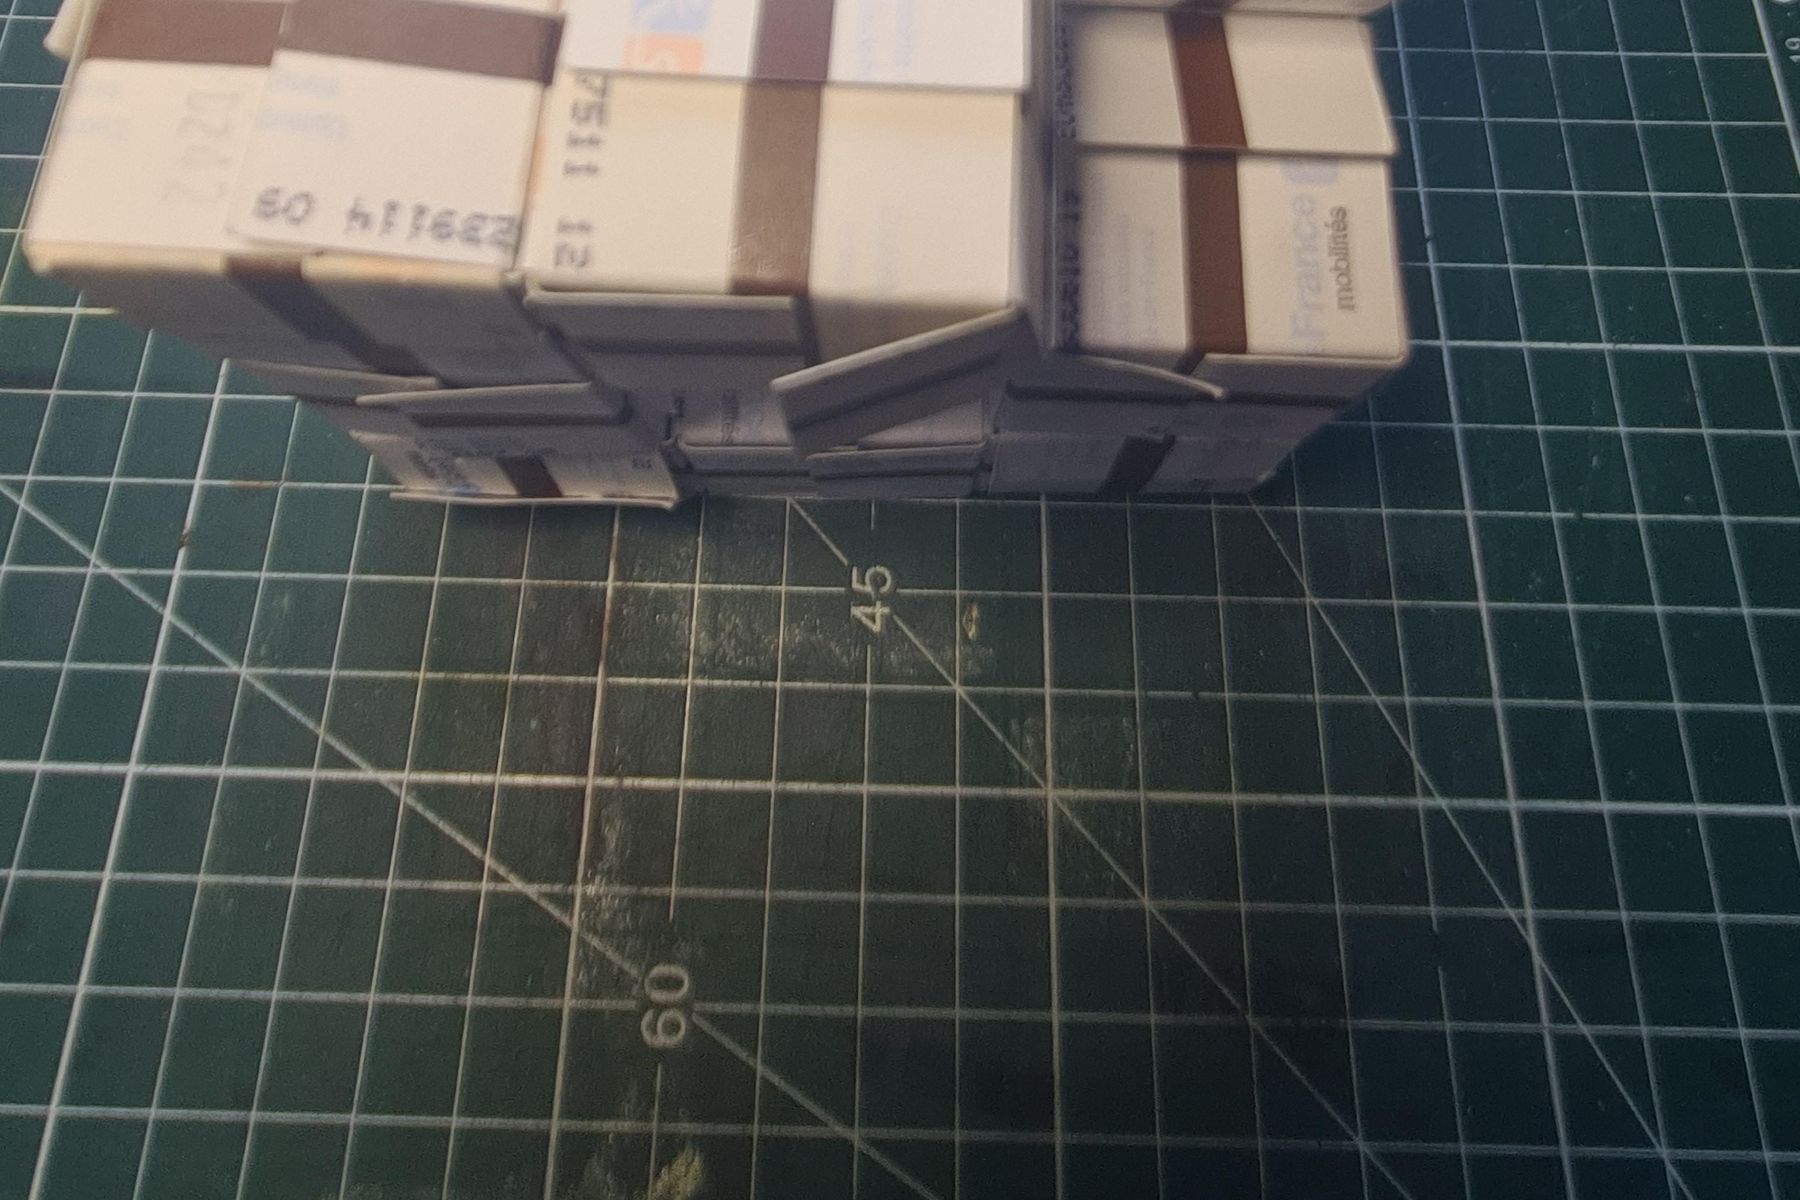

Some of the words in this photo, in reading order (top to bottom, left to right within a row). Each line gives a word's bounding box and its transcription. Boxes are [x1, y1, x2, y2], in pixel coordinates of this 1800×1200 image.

[1328, 205, 1358, 312] mobilités
[851, 563, 894, 636] 45
[640, 962, 692, 1049] 60
